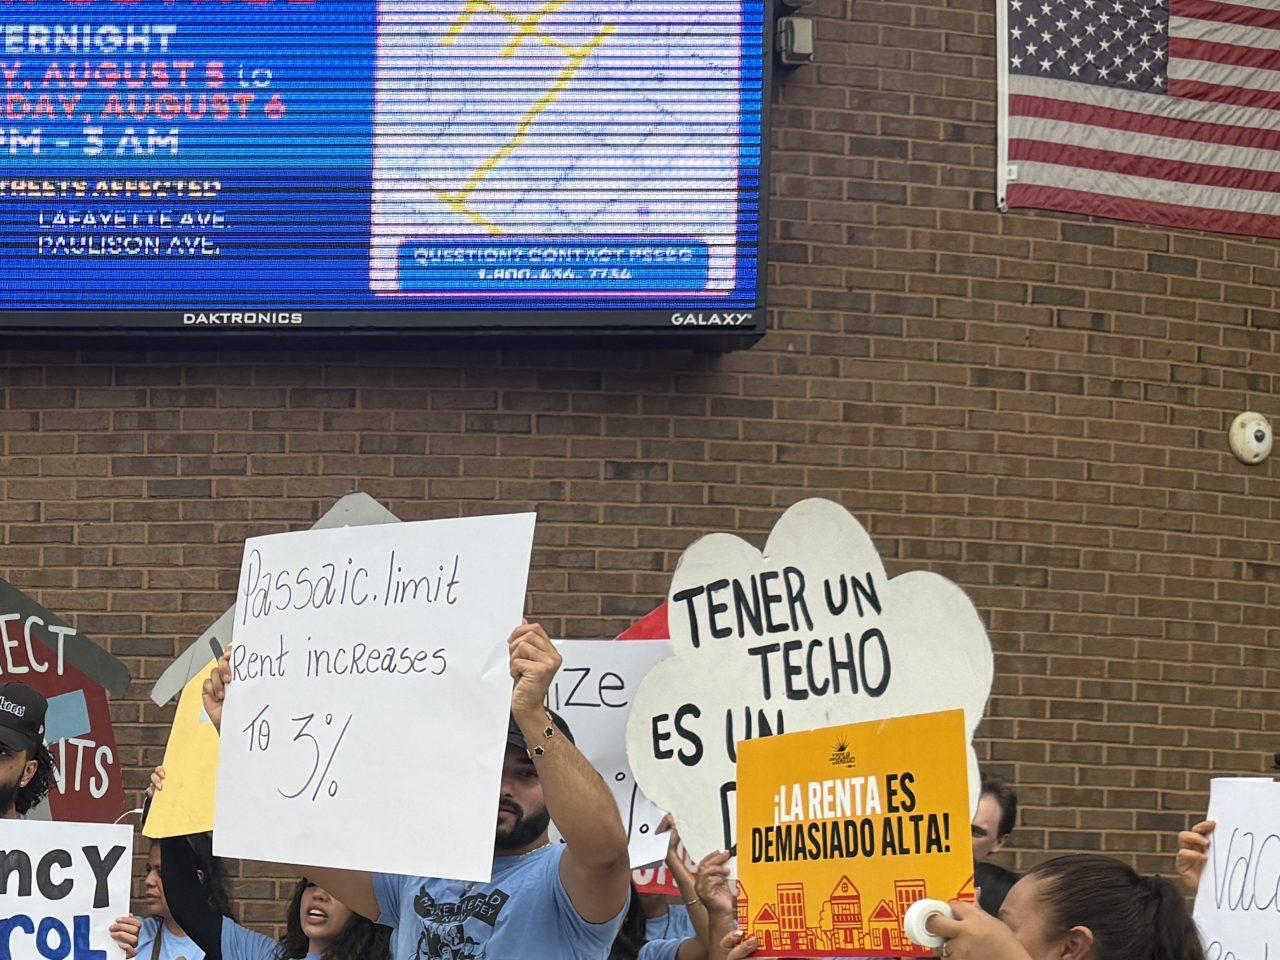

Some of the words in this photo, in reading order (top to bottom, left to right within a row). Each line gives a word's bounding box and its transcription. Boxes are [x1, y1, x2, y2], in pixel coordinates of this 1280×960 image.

[41, 60, 195, 88] AUGUST
[204, 60, 224, 88] 5
[237, 63, 273, 88] to
[100, 92, 255, 120] AUGUST
[264, 93, 287, 119] 6
[115, 127, 180, 156] AM
[91, 178, 222, 197] AFFECTED
[37, 209, 174, 229] LAFAYETTE
[37, 235, 161, 255] PAULISON
[528, 249, 625, 262] CONTACT
[182, 312, 303, 325] DAKTRONICS
[382, 549, 462, 607] limit
[672, 565, 814, 649] TENER
[823, 570, 883, 618] UN
[747, 627, 892, 701] TECHO
[651, 703, 705, 767] ES
[276, 712, 354, 802] 3%
[773, 783, 805, 832] ¡LA
[807, 775, 882, 820] RENTA
[885, 771, 917, 814] ES
[751, 817, 876, 864] DEMASIADO
[880, 812, 952, 857] ALTA!
